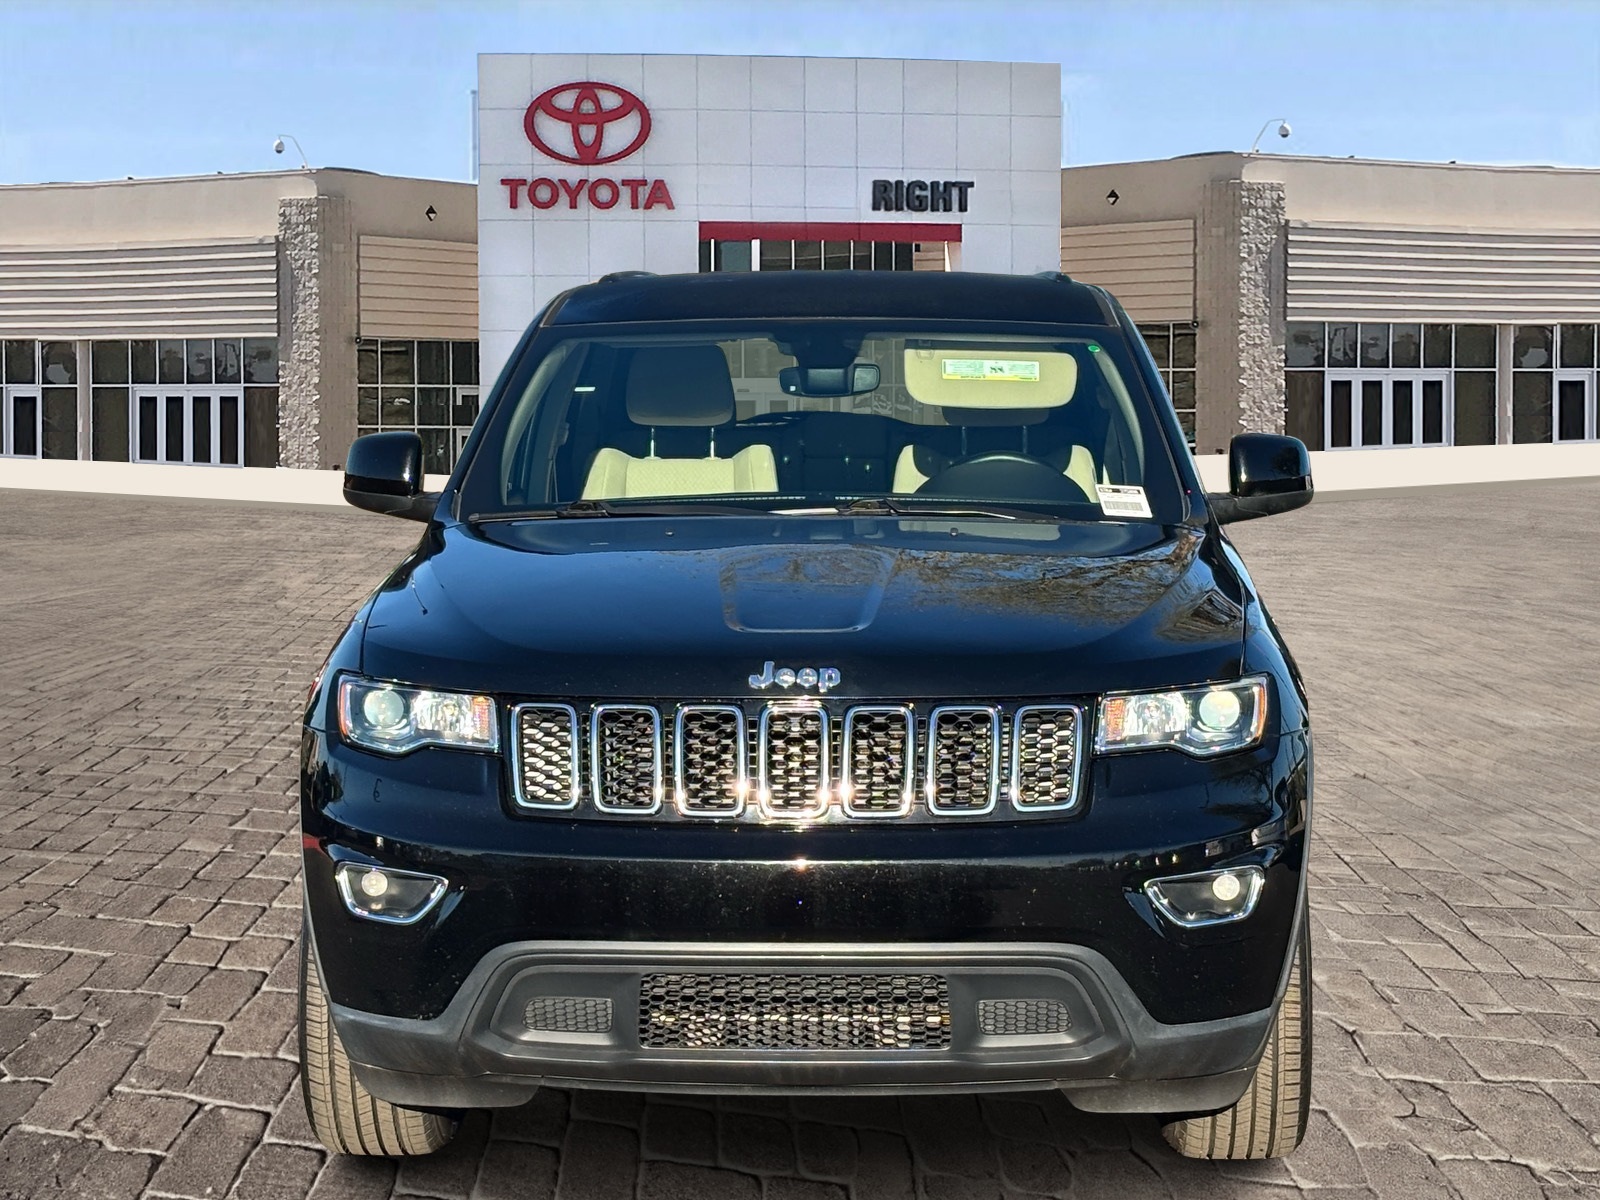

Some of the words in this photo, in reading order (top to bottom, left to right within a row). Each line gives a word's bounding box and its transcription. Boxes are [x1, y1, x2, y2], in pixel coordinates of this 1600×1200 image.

[500, 178, 675, 210] TOYOTA
[871, 179, 974, 212] RIGHT
[748, 661, 841, 693] Jeep
